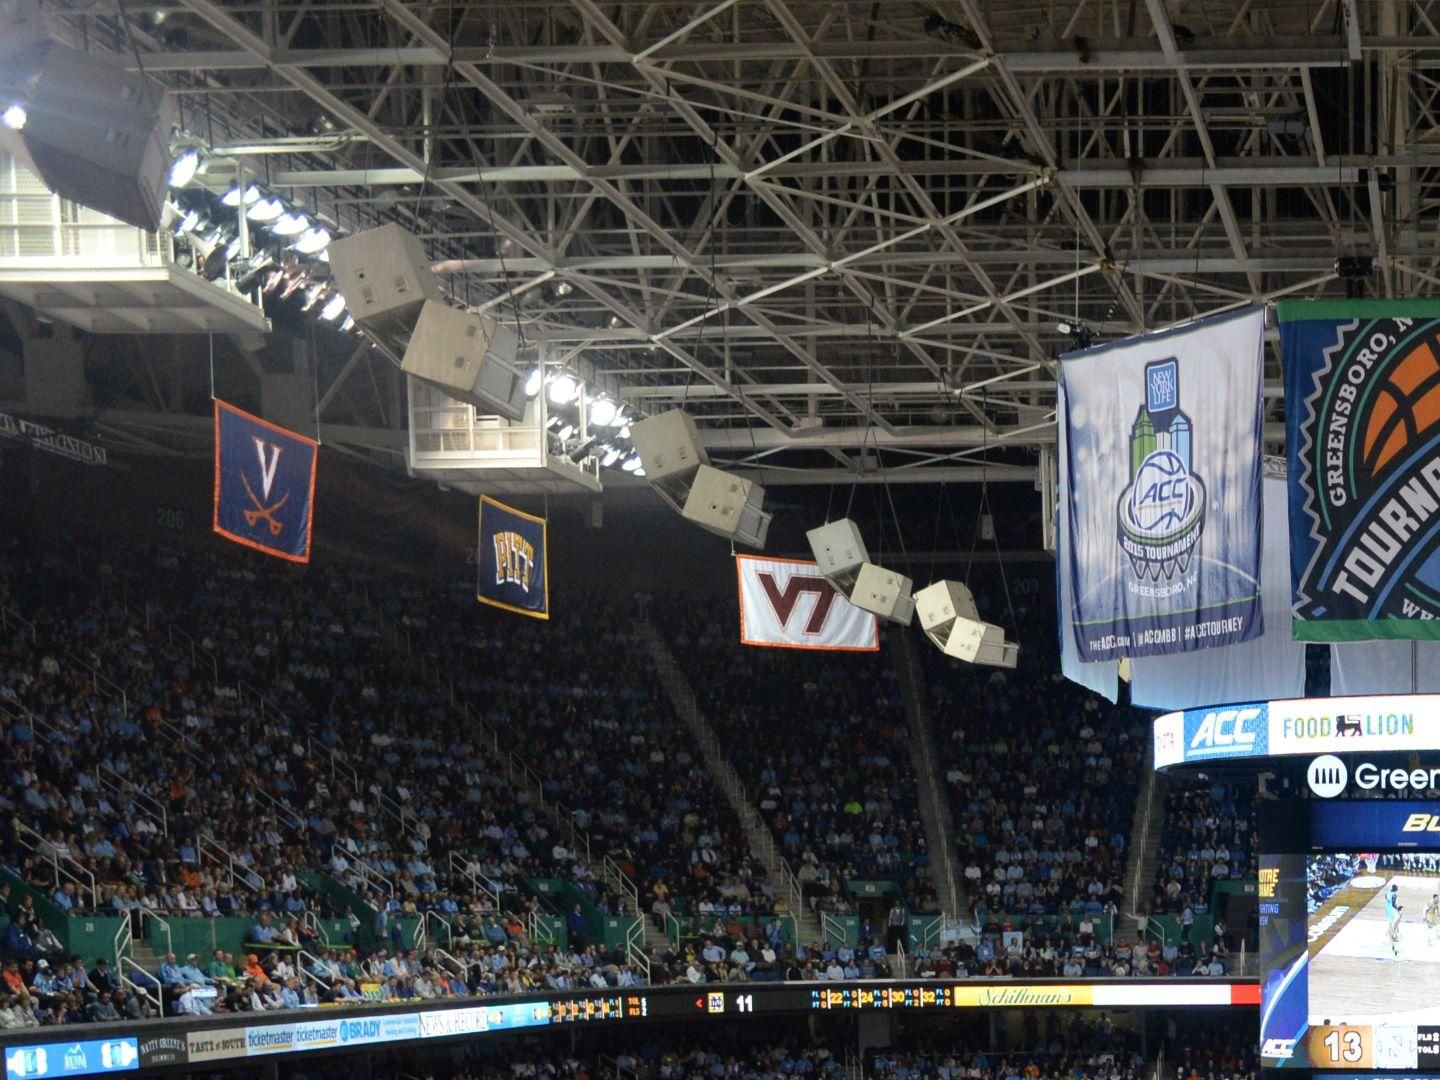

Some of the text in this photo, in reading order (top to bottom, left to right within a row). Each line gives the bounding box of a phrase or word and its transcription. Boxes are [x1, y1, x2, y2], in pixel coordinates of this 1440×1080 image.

[1153, 370, 1172, 384] NEW
[1151, 379, 1173, 394] YORK
[1154, 391, 1172, 404] LIFE
[1330, 331, 1396, 507] GREENSBORO,
[252, 437, 283, 500] V
[1141, 478, 1187, 504] ACC
[1123, 522, 1200, 560] 2015 TOURNAMENT
[493, 531, 535, 593] PITT
[1129, 582, 1185, 598] GREENSBORO,
[1184, 617, 1243, 640] #ACCTOURNEY
[1191, 708, 1261, 748] ACC
[1284, 714, 1414, 738] FOOD LION
[736, 995, 753, 1012] 11
[831, 993, 843, 1003] 22
[862, 992, 874, 1003] 24
[892, 991, 904, 1002] 30
[923, 991, 935, 1002] 32
[297, 1026, 337, 1043] ticketmaster
[350, 1020, 381, 1038] BRADY
[248, 1030, 293, 1048] ticketmaster
[1324, 1031, 1363, 1062] 13
